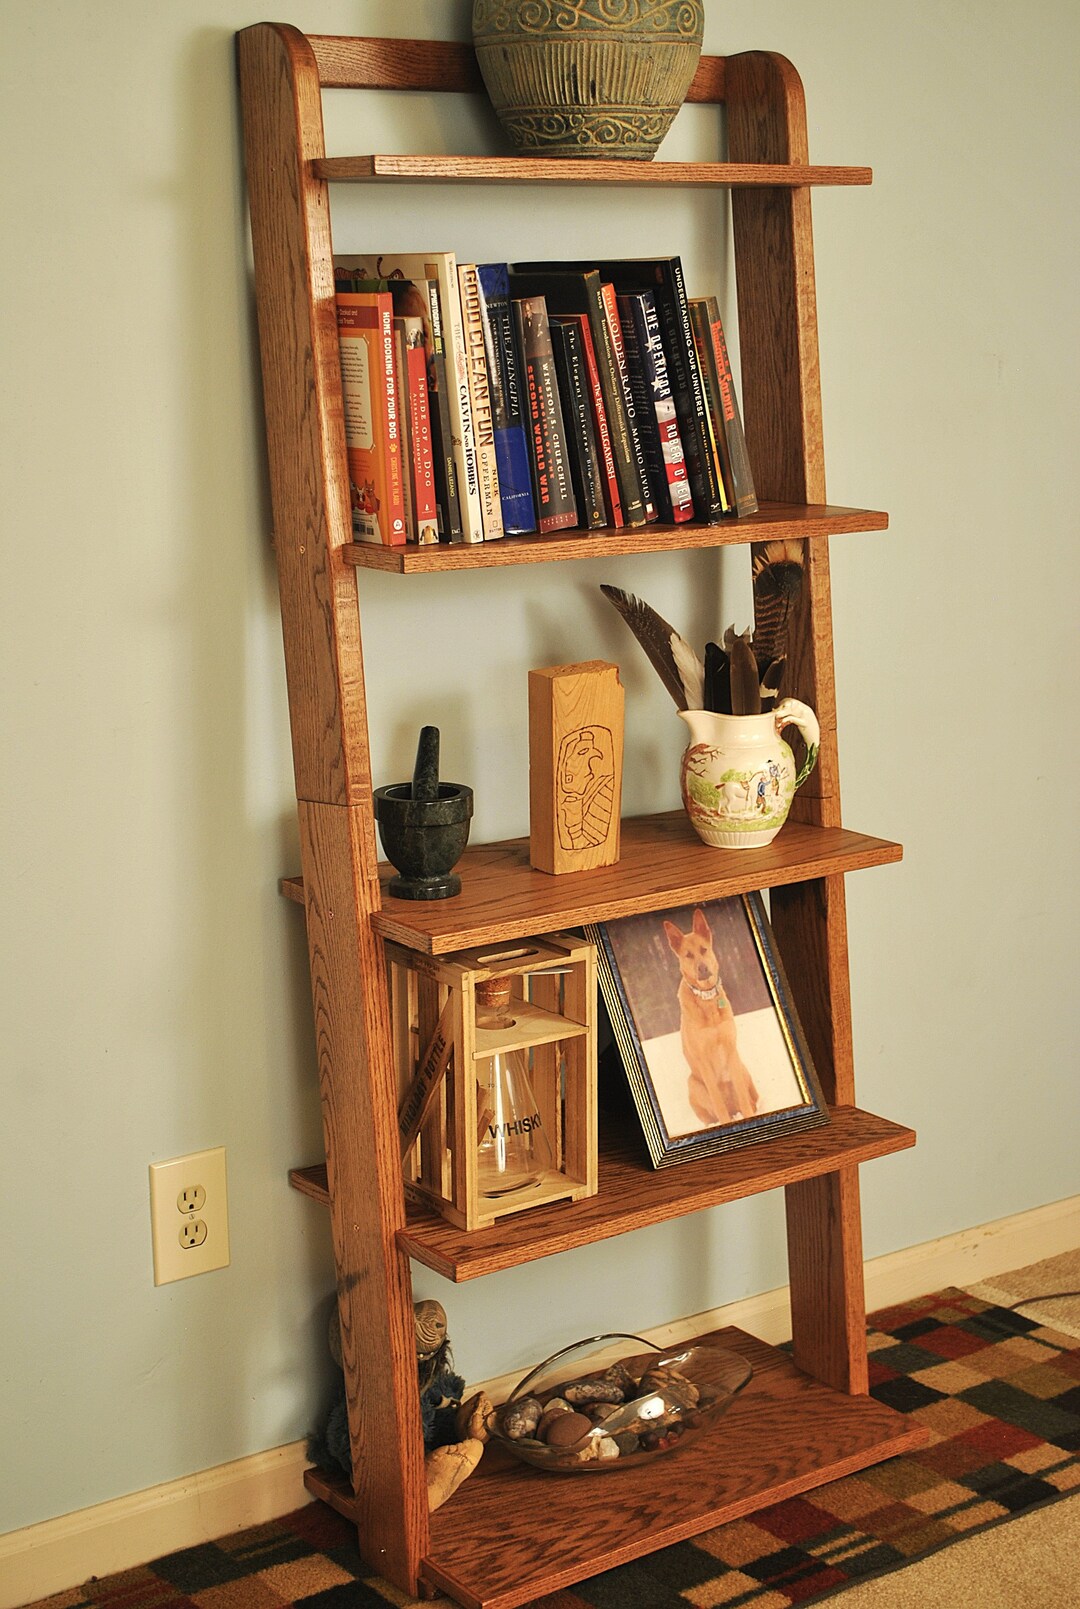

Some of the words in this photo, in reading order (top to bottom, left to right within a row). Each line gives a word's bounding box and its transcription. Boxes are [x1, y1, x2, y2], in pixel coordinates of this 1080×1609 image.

[431, 293, 441, 336] PHOTOGRAPHY
[463, 270, 481, 324] GOOD
[486, 302, 508, 310] NEWTON
[606, 291, 614, 310] THE
[383, 312, 391, 336] HOME
[502, 315, 511, 345] THE
[646, 307, 659, 331] THE
[384, 338, 394, 375] COOKING
[434, 338, 442, 354] BIBLE
[609, 312, 627, 371] GOLDEN
[674, 267, 692, 347] UNDERSTANDING
[688, 349, 696, 370] OUR
[692, 372, 704, 417] UNIVERSE
[469, 329, 489, 400] CLEAN
[504, 348, 520, 416] PRINCIPIA
[651, 334, 671, 398] OPERATOR
[386, 378, 394, 395] FOR
[387, 396, 396, 420] YOUR
[418, 377, 427, 420] INSIDE
[542, 362, 556, 415] WINSTON
[572, 356, 582, 398] Elegant
[579, 404, 589, 453] Universe
[595, 397, 604, 413] Epic
[601, 319, 611, 359] Introduction
[610, 367, 618, 396] Ordinary
[615, 396, 626, 434] Differential
[621, 433, 631, 463] Equations
[621, 374, 636, 418] RATIO
[719, 373, 735, 421] SOLDIER
[460, 385, 471, 433] CALVIN
[476, 406, 494, 448] FUN
[538, 386, 548, 436] MEMOIRS
[546, 442, 551, 454] OF
[551, 419, 556, 429] S.
[600, 413, 606, 422] of
[388, 422, 397, 440] DOG
[421, 426, 428, 441] OF
[527, 365, 538, 419] SECOND
[534, 423, 546, 470] WORLD
[540, 474, 550, 504] WAR
[600, 422, 616, 479] GILGAMESH
[632, 427, 644, 465] MARIO
[666, 423, 683, 465] ROBERT
[465, 448, 477, 496] HOBBES
[481, 452, 493, 516] OFFERMAN
[552, 434, 568, 500] CHURCHILL
[639, 468, 650, 498] LIVIO
[502, 492, 529, 501] CALIFORNIA
[674, 468, 691, 511] O'NEILL
[424, 1034, 446, 1080] BOTTLE
